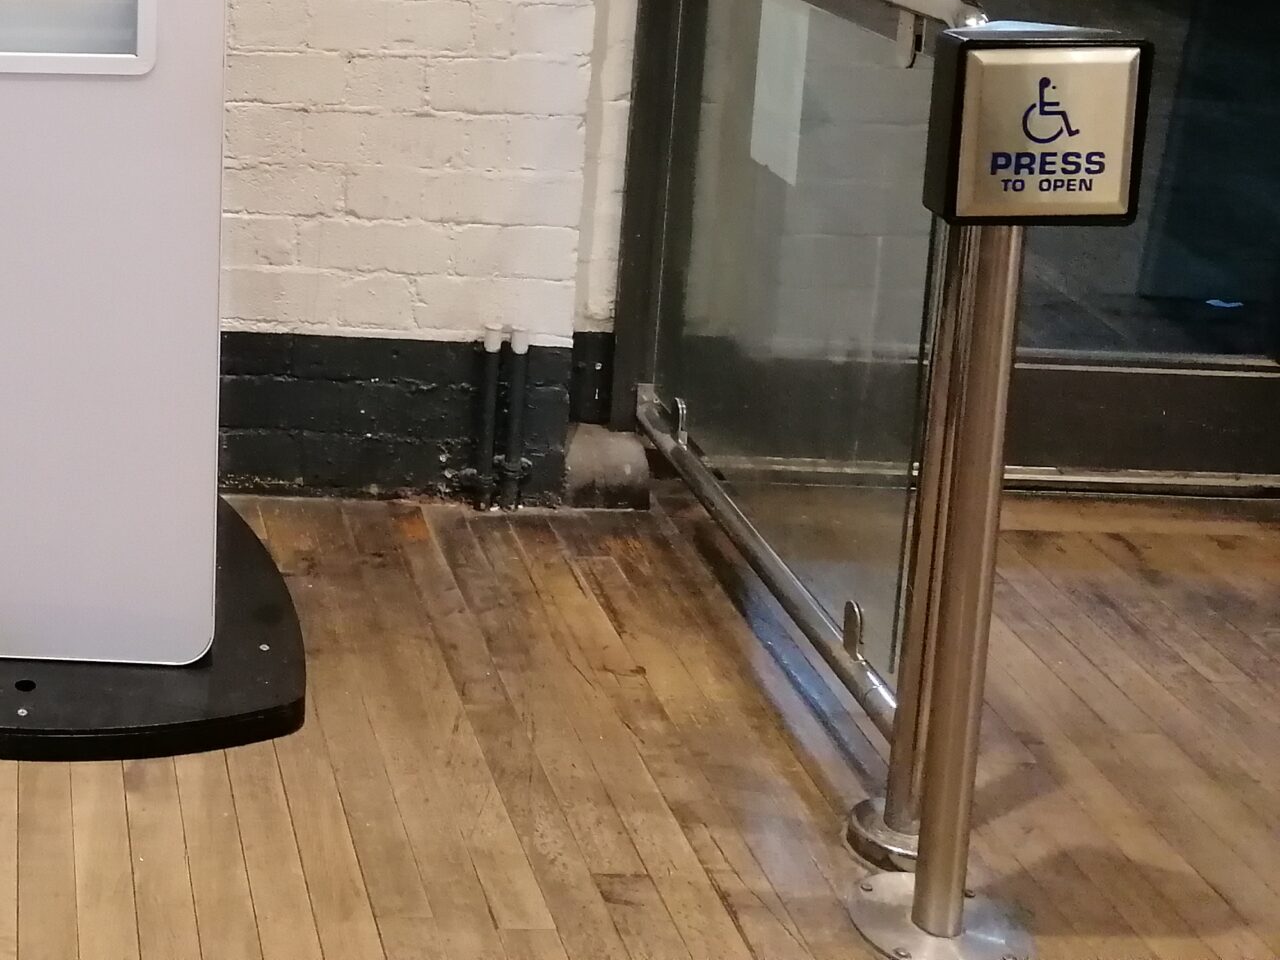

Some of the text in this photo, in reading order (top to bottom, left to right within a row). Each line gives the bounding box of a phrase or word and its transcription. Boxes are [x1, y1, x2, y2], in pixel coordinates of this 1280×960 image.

[990, 152, 1106, 175] PRESS
[1001, 179, 1093, 192] TO OPEN
